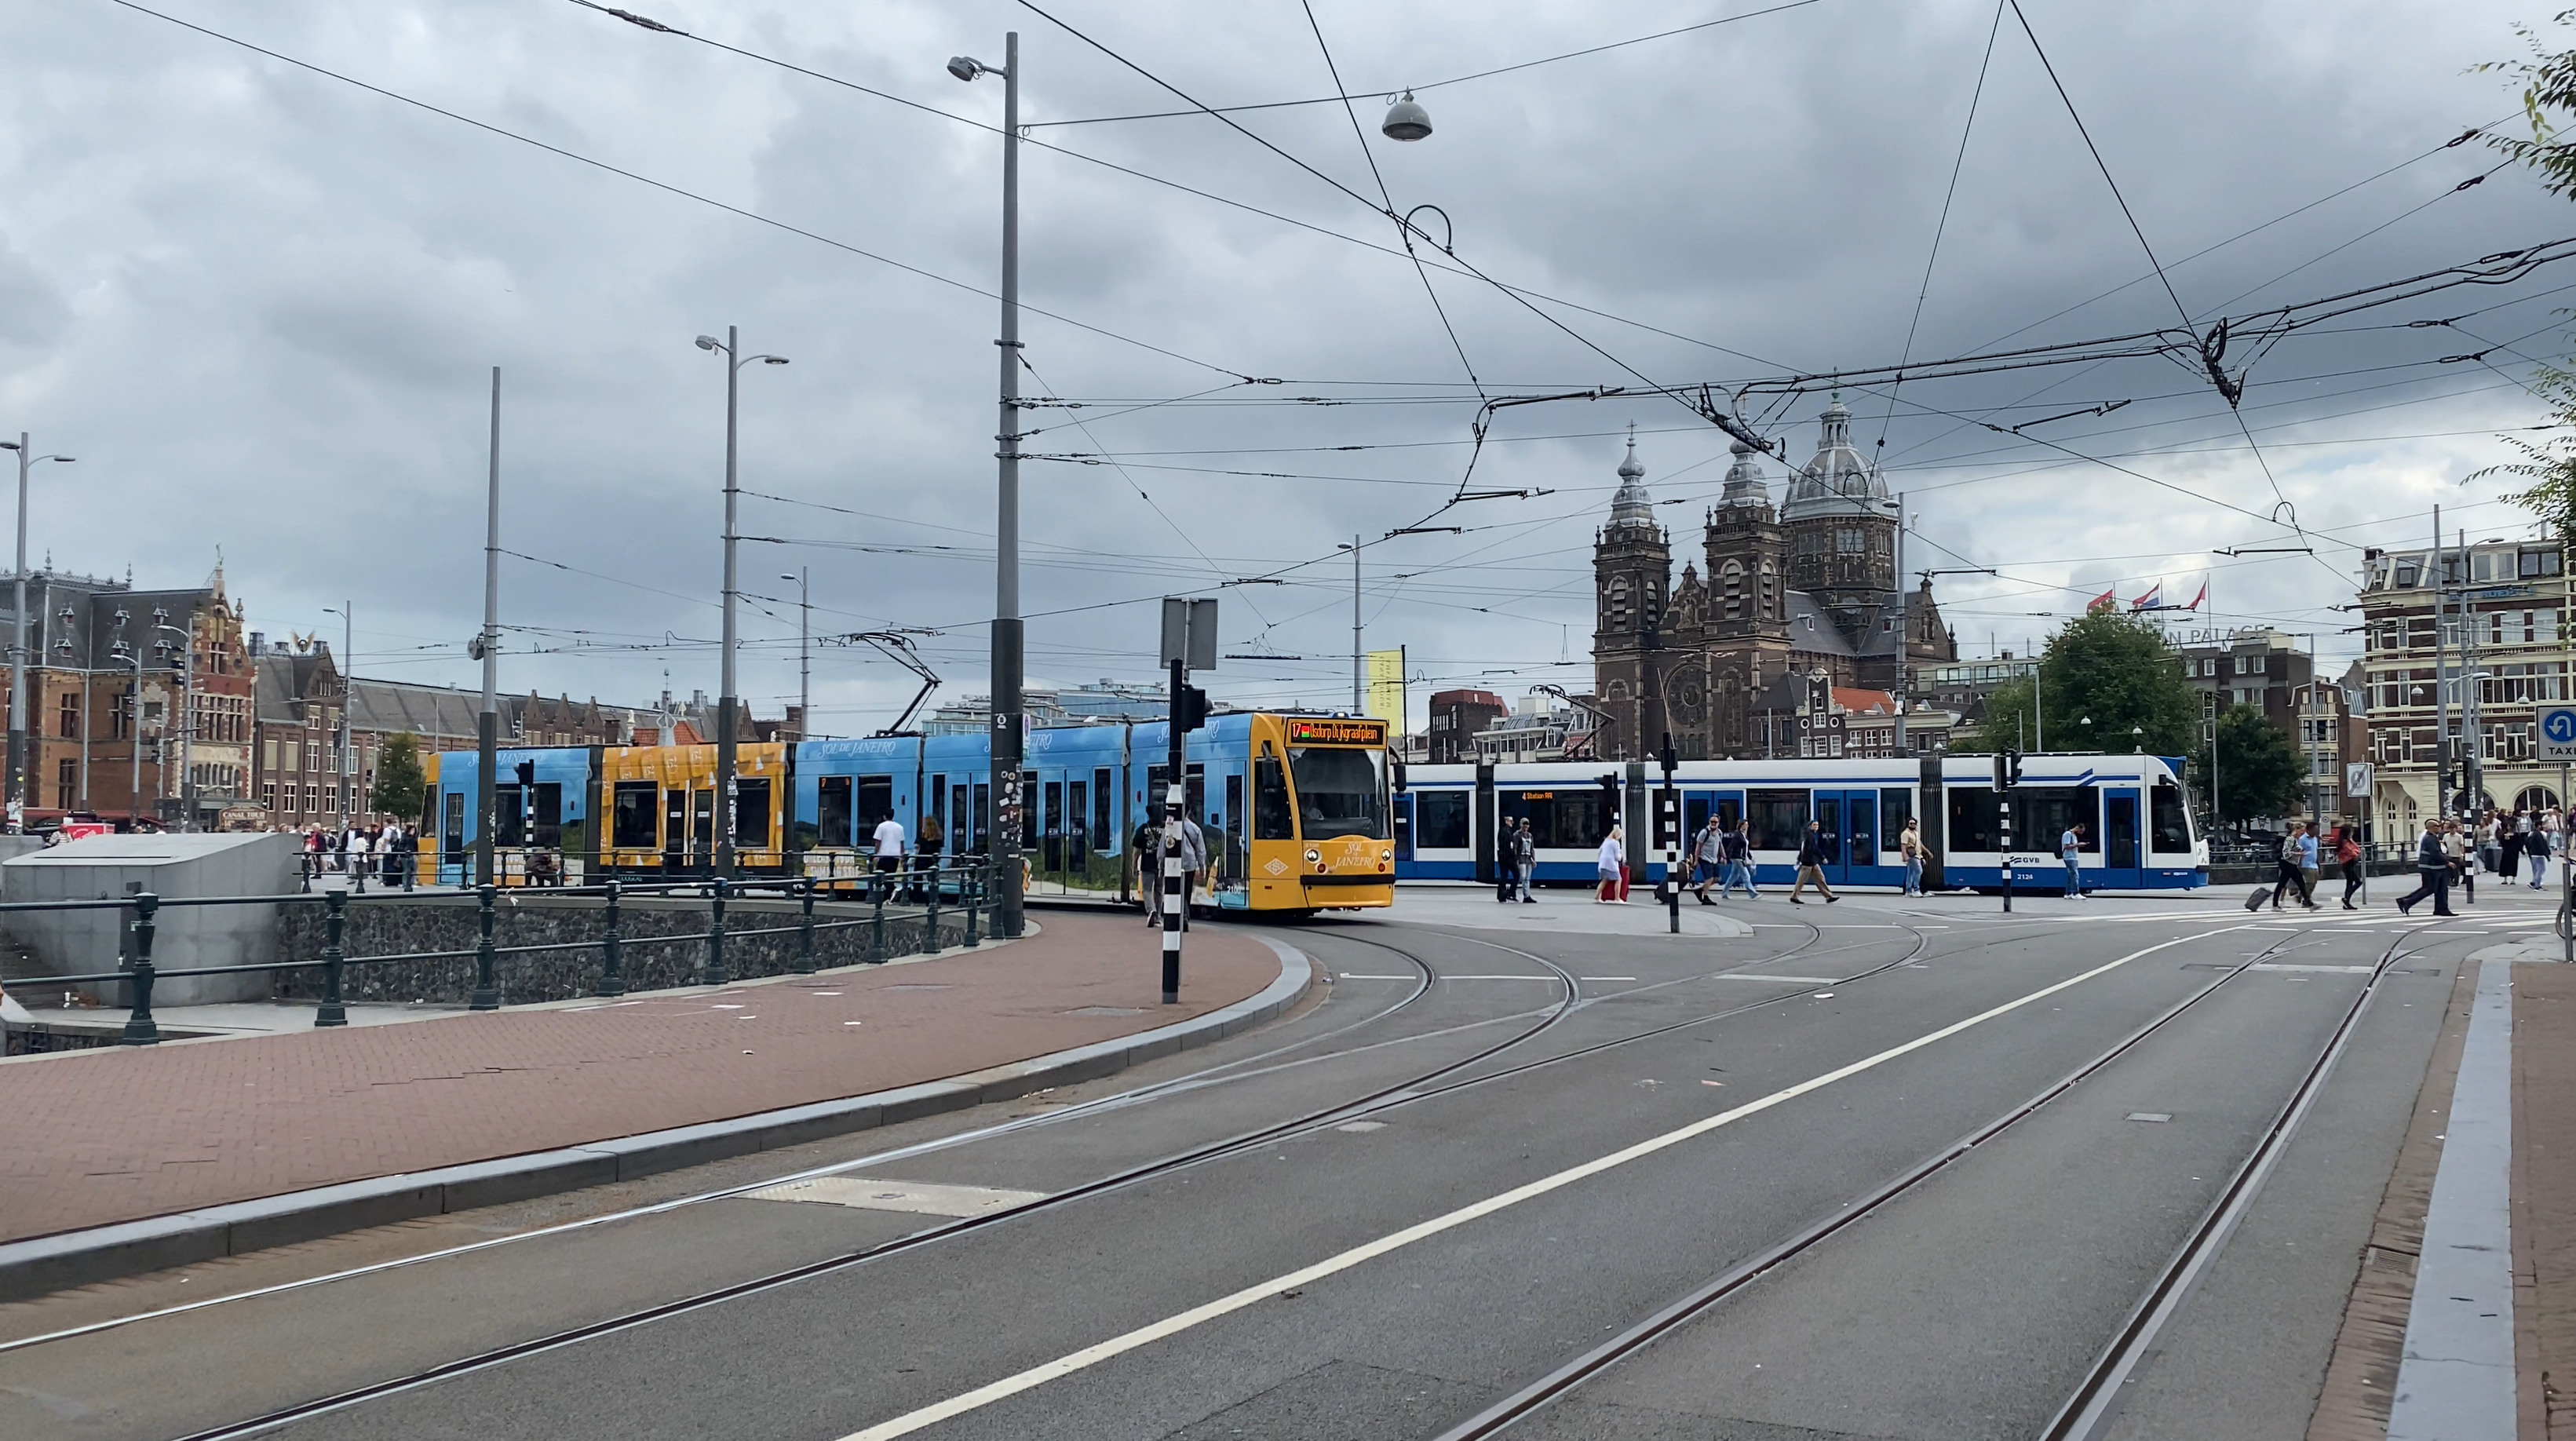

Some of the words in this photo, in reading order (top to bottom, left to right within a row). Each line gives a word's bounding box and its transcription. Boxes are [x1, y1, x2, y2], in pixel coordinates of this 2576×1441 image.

[1292, 723, 1301, 738] 17
[1310, 723, 1332, 742] Osdorp
[818, 743, 838, 758] SOL
[839, 742, 852, 752] DE
[2548, 746, 2576, 756] TAXI
[1522, 792, 1527, 801] 4
[1345, 842, 1363, 854] SOL
